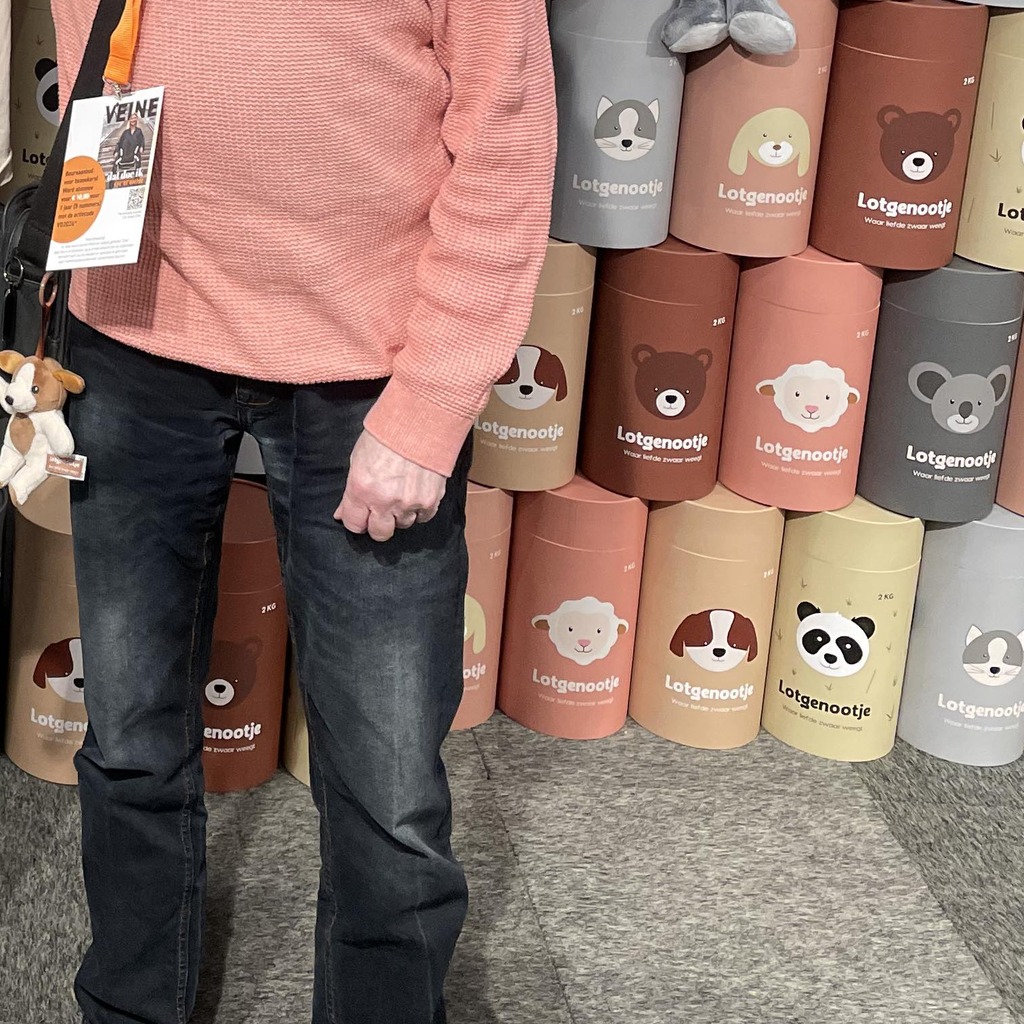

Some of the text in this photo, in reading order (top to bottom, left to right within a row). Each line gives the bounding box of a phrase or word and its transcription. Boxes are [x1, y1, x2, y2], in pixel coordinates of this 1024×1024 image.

[106, 97, 160, 124] VEINE
[572, 174, 663, 198] Lotgenootje
[718, 183, 808, 207] Lotgenootje
[857, 192, 952, 219] Lotgenootje
[865, 217, 885, 226] Waar
[617, 426, 709, 452] Lotgenootje
[755, 436, 849, 464] Lotgenootje
[623, 449, 641, 457] Waar
[906, 445, 997, 470] Lotgenootje
[913, 470, 933, 479] Waar
[532, 668, 620, 694] Lotgenootje
[665, 674, 754, 701] Lotgenootje
[778, 679, 871, 720] Lotgenootje
